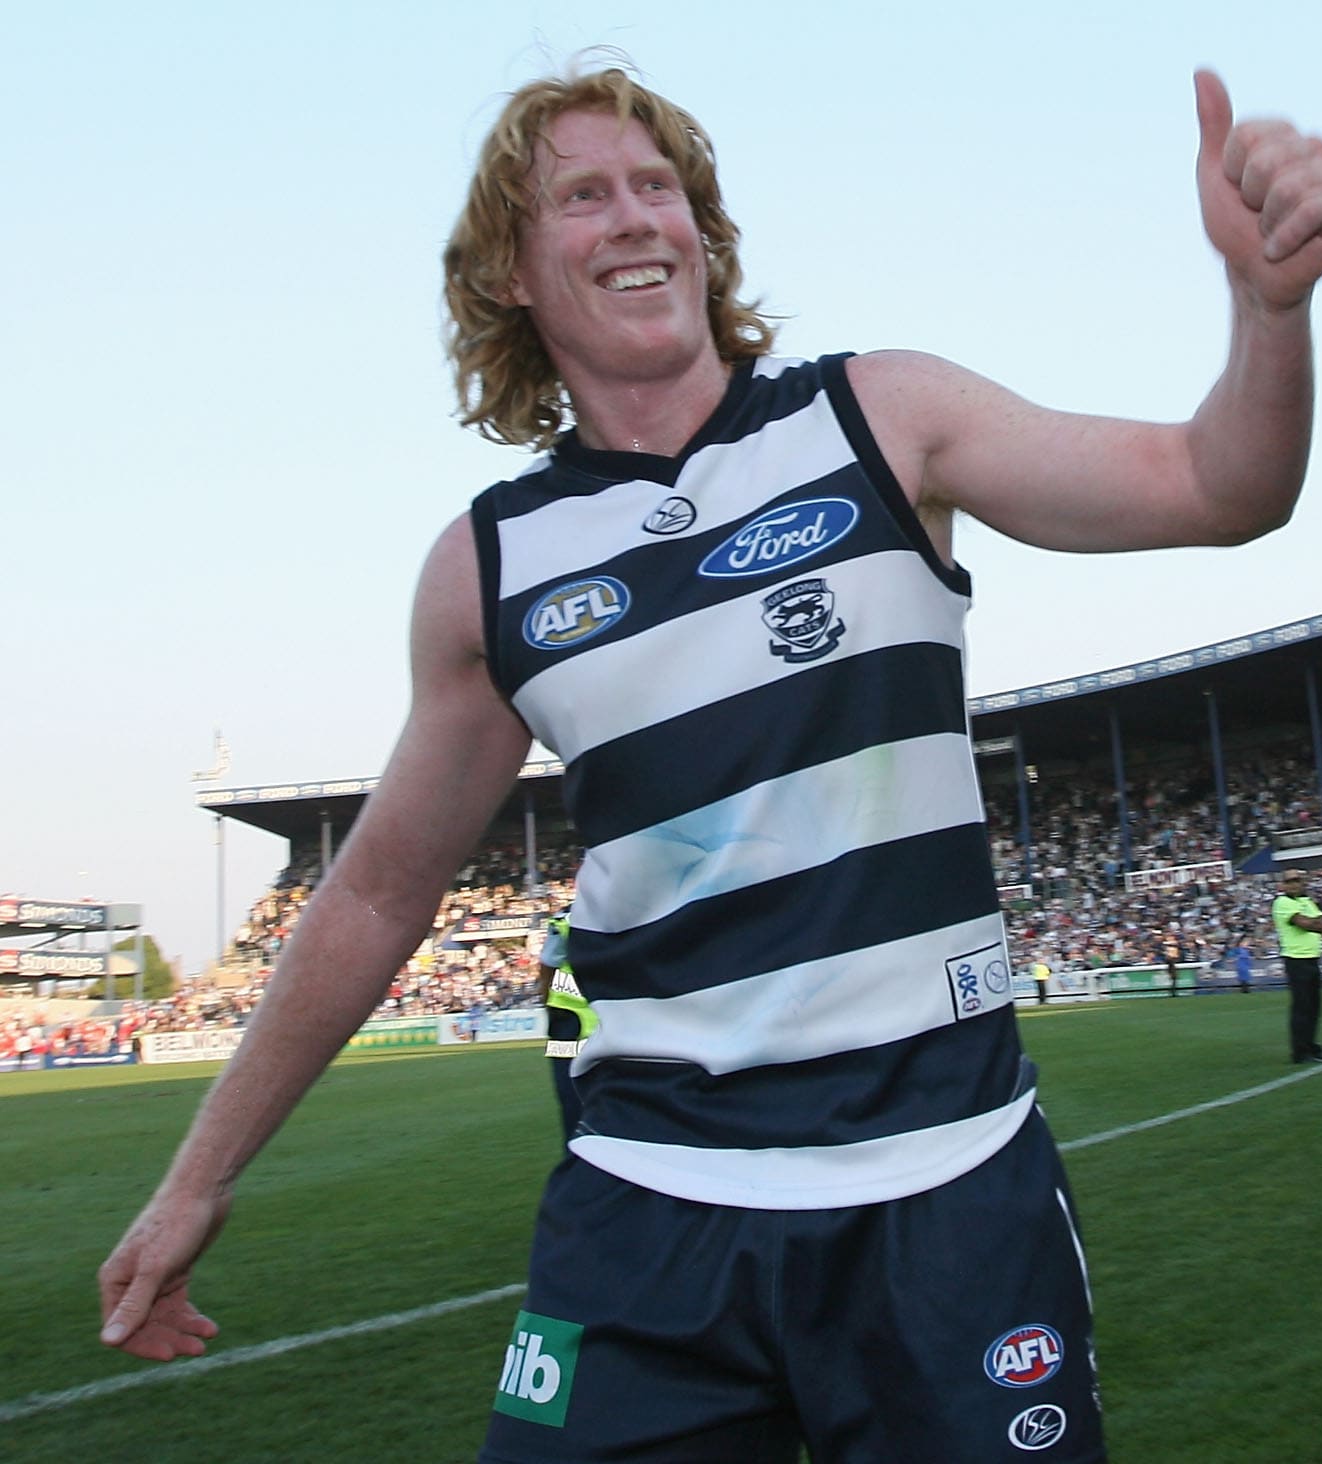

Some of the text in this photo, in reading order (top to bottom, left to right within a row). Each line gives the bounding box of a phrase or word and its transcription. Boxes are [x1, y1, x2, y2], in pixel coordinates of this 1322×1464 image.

[728, 512, 828, 569] Ford
[534, 587, 621, 642] AFL
[767, 582, 821, 606] GEELONG
[789, 621, 820, 636] CATS
[995, 1335, 1060, 1378] AFL
